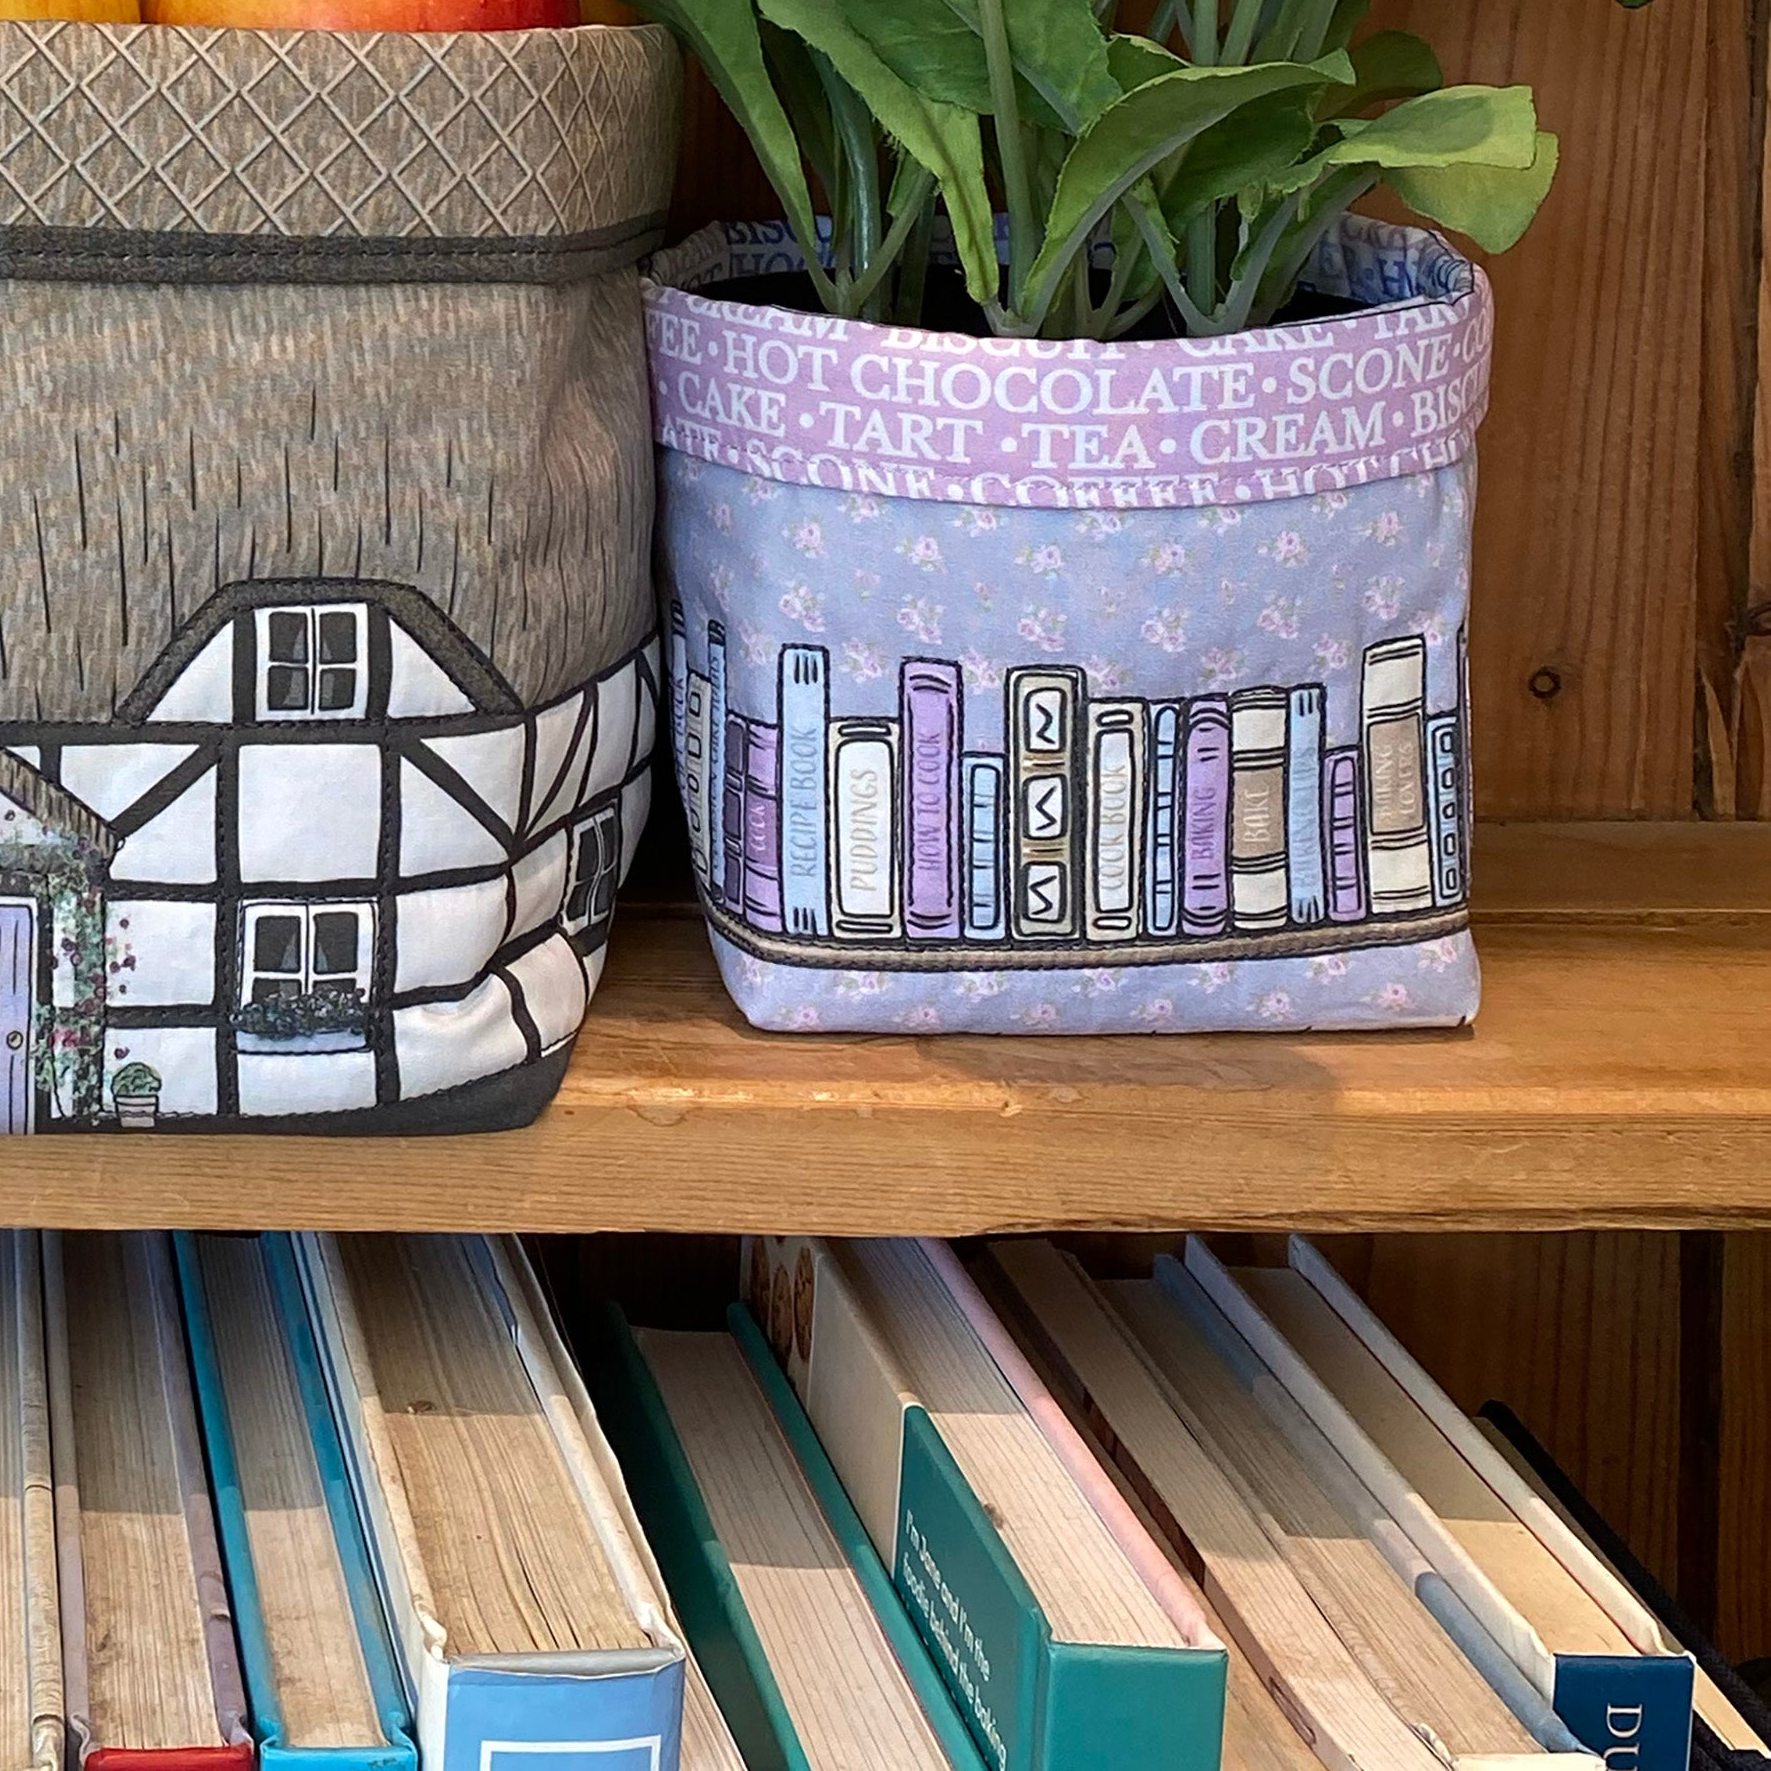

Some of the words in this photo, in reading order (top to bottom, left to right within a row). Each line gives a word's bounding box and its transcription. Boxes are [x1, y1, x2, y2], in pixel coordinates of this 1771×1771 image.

[722, 330, 838, 392] HOT
[850, 353, 1256, 415] CHOCOLATE
[1286, 332, 1453, 405] SCONE
[678, 371, 787, 438] CAKE
[819, 400, 983, 464] TART
[1021, 422, 1156, 470] TEA
[1189, 400, 1386, 466] CREAM
[788, 726, 818, 789] BOOK
[917, 731, 941, 785] COOK
[1372, 743, 1394, 820] BAKING
[749, 802, 767, 852] COOK
[917, 792, 941, 815] TO
[1098, 763, 1128, 826] BOOK
[1188, 785, 1217, 860] BAKING
[1242, 783, 1271, 843] BAKE
[788, 800, 819, 878] RECIPE
[849, 768, 879, 893] PUDDINGS
[917, 823, 944, 872] HOW
[1098, 832, 1127, 891] COOK
[902, 1551, 930, 1619] foodie
[929, 1599, 960, 1676] behind
[958, 1660, 975, 1705] the
[940, 1581, 960, 1625] and
[973, 1636, 991, 1682] the
